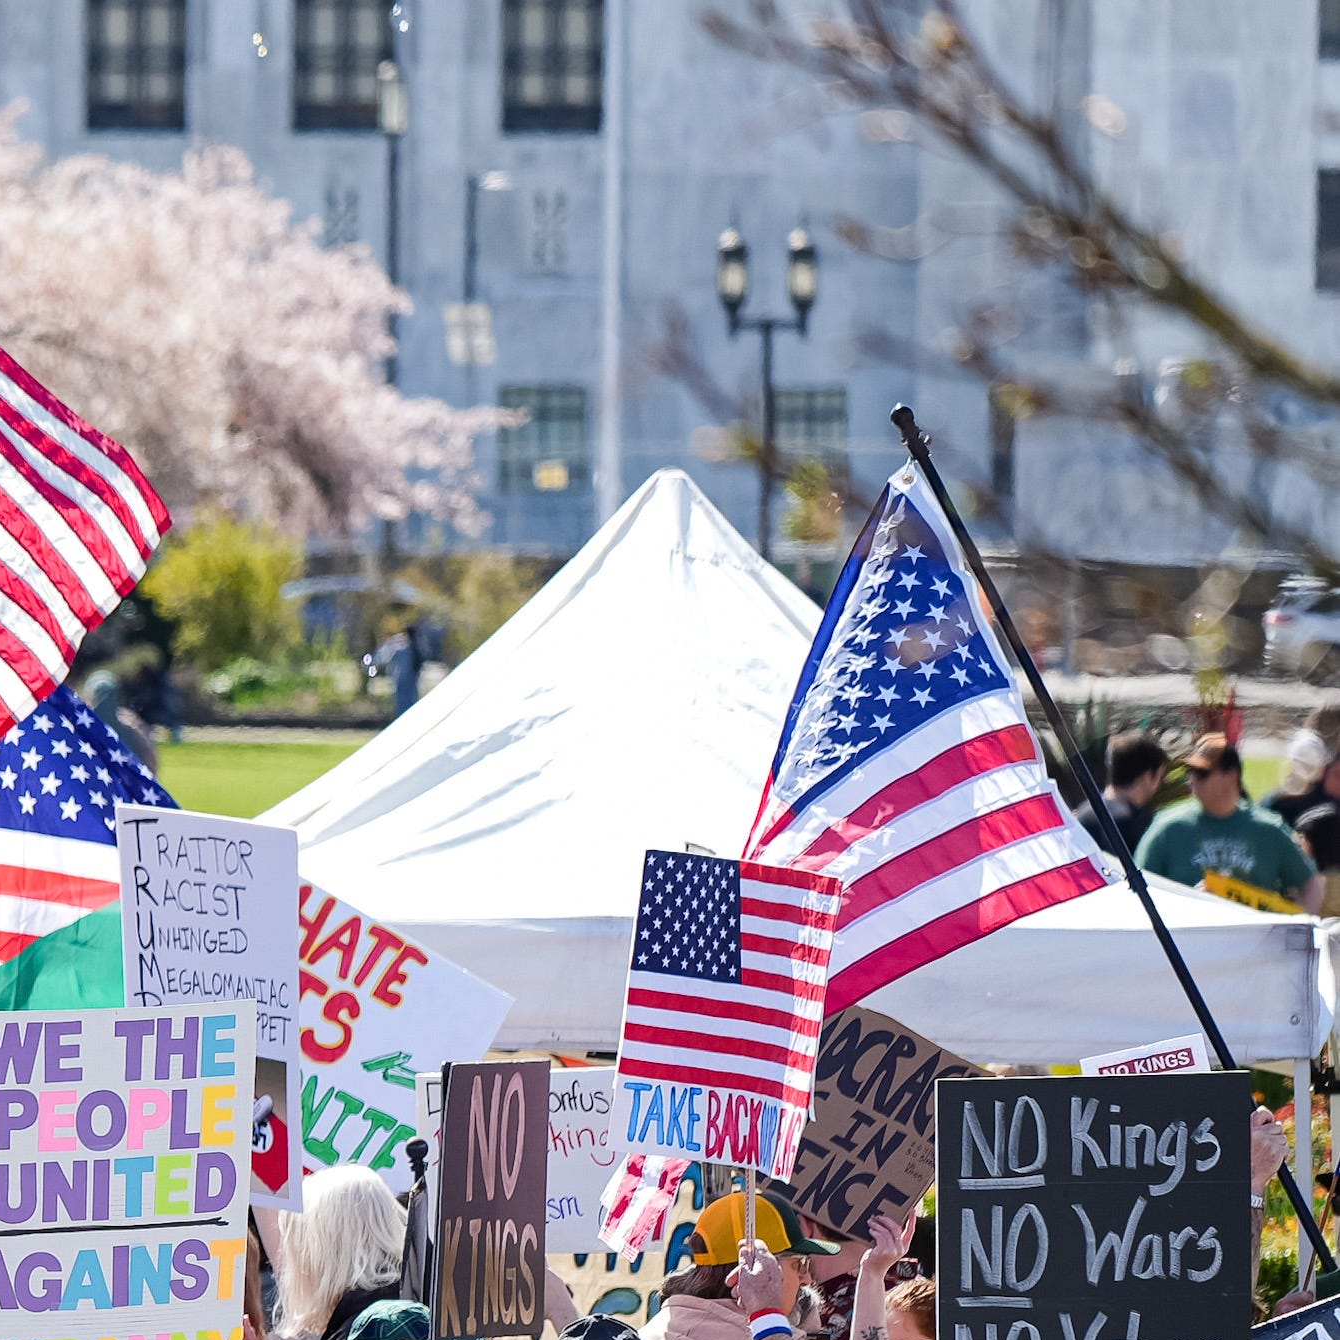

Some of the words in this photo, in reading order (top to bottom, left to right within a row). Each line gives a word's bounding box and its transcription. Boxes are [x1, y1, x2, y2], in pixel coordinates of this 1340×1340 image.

[122, 817, 254, 879] TRAITOR
[133, 866, 246, 920] RACIST
[135, 914, 249, 954] UNHINGED
[299, 884, 428, 1009] HATE
[114, 1014, 236, 1081] THE
[1134, 1051, 1190, 1073] KINGS
[466, 1071, 525, 1202] NO
[624, 1081, 702, 1153] TAKE
[705, 1090, 761, 1165] BACK
[830, 1110, 908, 1172] IN
[959, 1095, 1048, 1178] NO
[1069, 1096, 1221, 1196] Kings
[440, 1216, 538, 1337] KINGS
[960, 1203, 1049, 1292] NO
[1070, 1196, 1224, 1287] Wars
